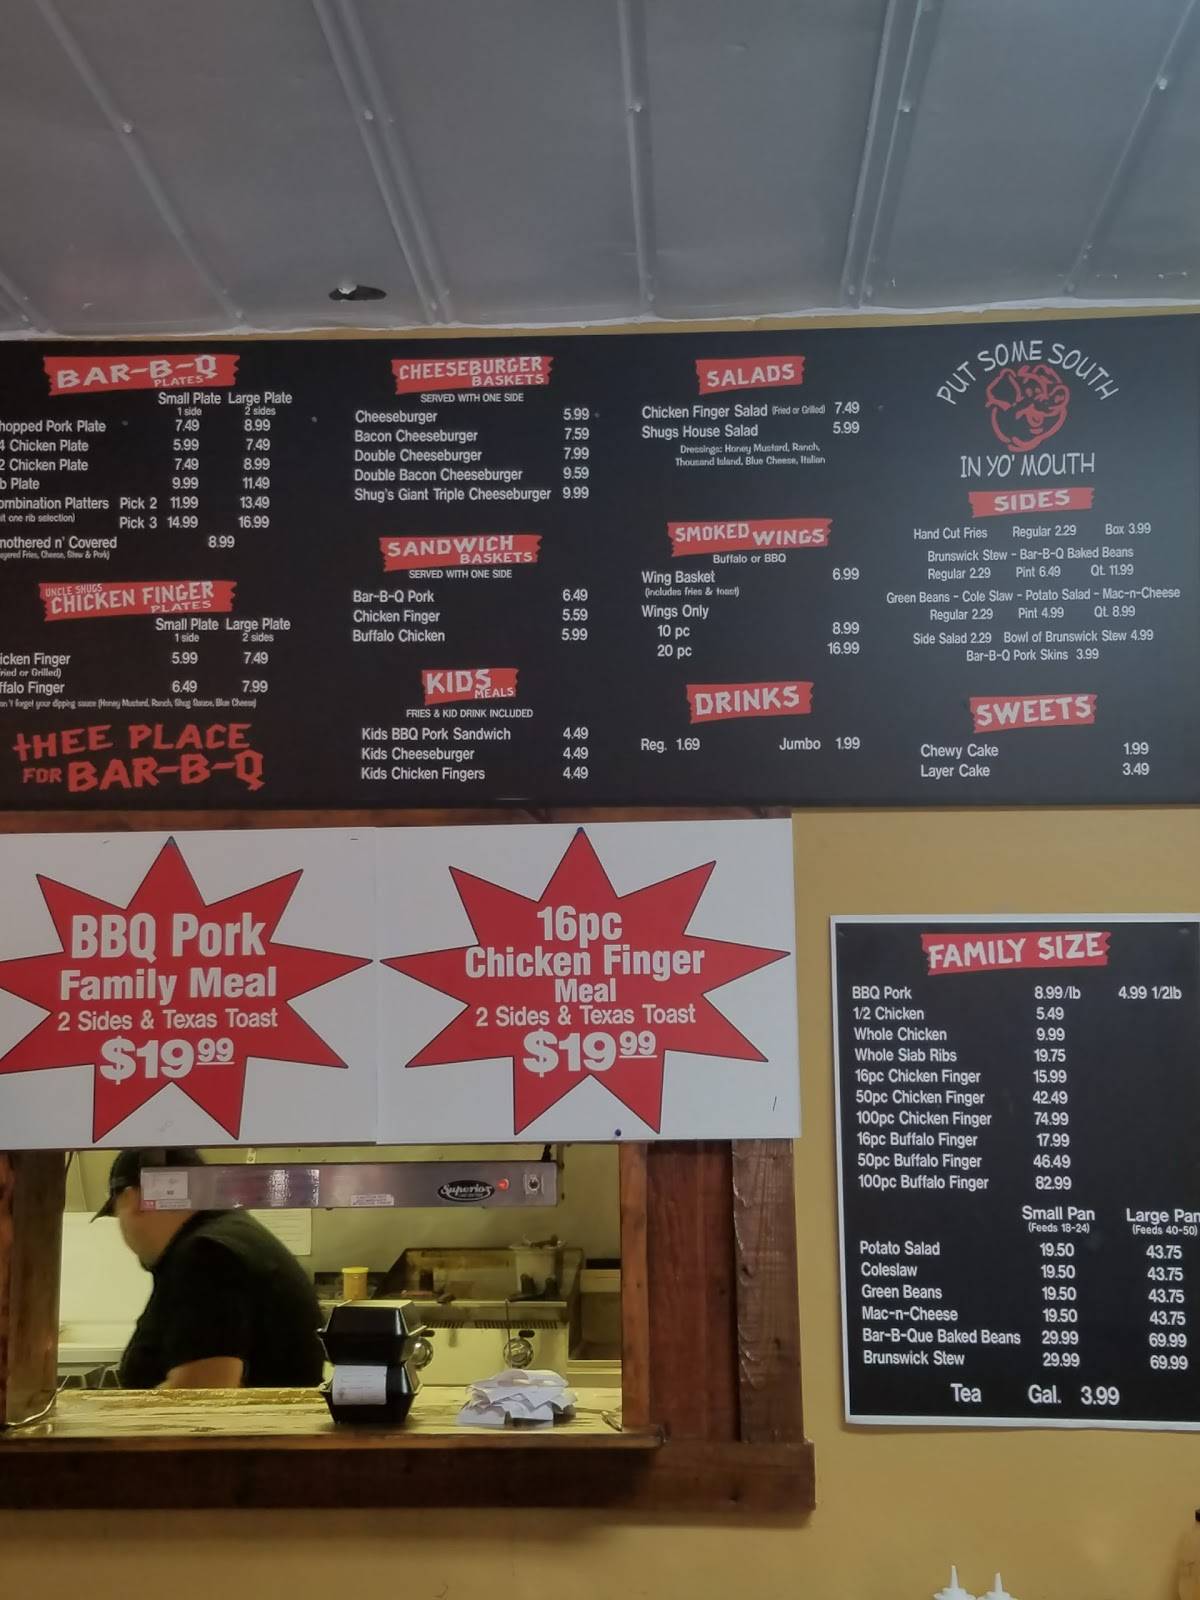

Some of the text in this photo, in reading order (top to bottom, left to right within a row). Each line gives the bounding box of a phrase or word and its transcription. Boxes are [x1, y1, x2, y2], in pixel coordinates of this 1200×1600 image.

[56, 355, 218, 389] BAR-B-Q
[400, 356, 542, 380] CHEESEBURGER
[707, 363, 795, 387] SALADS
[937, 341, 1119, 405] PUT SOME SOUTH
[154, 374, 204, 387] PLATES
[472, 374, 544, 387] BASKETS
[158, 392, 221, 405] Small Plate
[228, 391, 292, 407] Large Plate
[420, 393, 524, 403] SERVED WITH ONE SIDE
[177, 407, 202, 416] 1 side
[245, 406, 276, 415] 2 sides
[563, 408, 589, 420] 5.99
[642, 404, 768, 420] Chicken Finger Salad
[835, 401, 860, 414] 7.49
[355, 410, 438, 424] Cheeseburger
[46, 420, 106, 432] Pork Plate
[175, 419, 200, 432] 7.49
[244, 418, 271, 432] 8.99
[642, 424, 758, 440] Shugs House Salad
[833, 421, 860, 434] 5.99
[960, 456, 981, 478] IN
[1021, 452, 1095, 477] MOUTH
[398, 488, 429, 501] Giant
[433, 488, 465, 503] Triple
[469, 487, 552, 502] Cheeseburger
[563, 486, 589, 499] 9.99
[120, 497, 157, 509] Pick 2
[170, 496, 199, 509] 11.99
[240, 496, 270, 509] 13.49
[994, 490, 1070, 512] SIDES
[119, 516, 157, 529] Pick 3
[167, 515, 198, 528] 14.99
[238, 515, 270, 528] 16.99
[1105, 522, 1151, 535] Box 3.99
[675, 523, 825, 545] SMOKED WINGS
[914, 527, 988, 540] Hand Cut Fries
[1013, 524, 1077, 539] Regular 2.29
[388, 535, 513, 557] SANDWICH
[460, 552, 533, 565] BASKETS
[713, 553, 786, 564] Buffalo or BBQ
[641, 570, 715, 586] Wing Basket
[832, 567, 860, 580] 6.99
[51, 581, 214, 614] CHICKEN FINGER
[151, 601, 211, 613] PLATES
[353, 609, 440, 624] Chicken Finger
[562, 608, 588, 621] 5.59
[34, 652, 71, 666] Finger
[172, 652, 198, 664] 5.99
[244, 651, 268, 664] 7.49
[427, 669, 492, 694] KIDS
[475, 688, 514, 699] MEALS
[695, 685, 800, 716] DRINKS
[406, 708, 533, 718] FRIES & KID DRINK INCLUDED
[975, 696, 1092, 727] SWEETS
[128, 723, 252, 750] PLACE
[362, 727, 511, 740] Kids BBQ Pork Sandwich
[563, 727, 589, 739] 4.49
[641, 738, 667, 753] Reg.
[676, 737, 700, 751] 1.69
[779, 737, 821, 750] Jumbo
[836, 736, 860, 749] 1.99
[1123, 742, 1149, 755] 1.99
[921, 743, 999, 759] Chewy Cake
[23, 749, 265, 793] FOR BAR-B-Q
[536, 905, 622, 948] 16pc
[71, 912, 266, 964] BBQ Pork
[928, 933, 1104, 970] FAMILY SIZE
[465, 944, 705, 981] Chicken Finger
[60, 966, 278, 1006] Family Meal
[555, 978, 616, 1003] Meal
[852, 985, 912, 1000] BBQ Pork
[1118, 986, 1147, 999] 4.99
[58, 1008, 278, 1032] 2 Sides & Texas Toast
[475, 1003, 696, 1027] 2 Sides & Texas Toast
[855, 1048, 957, 1062] Whole Slab Ribs
[1034, 1048, 1066, 1062] 19.75
[1022, 1205, 1095, 1221] Small Pan
[1028, 1222, 1090, 1234] (Feeds 18-24)
[860, 1241, 940, 1255] Potato Salad
[1040, 1243, 1074, 1257] 19.50
[1146, 1245, 1182, 1259] 43.75
[950, 1383, 982, 1402] Tea
[1028, 1384, 1062, 1404] Gal.
[1081, 1386, 1120, 1405] 3.99
